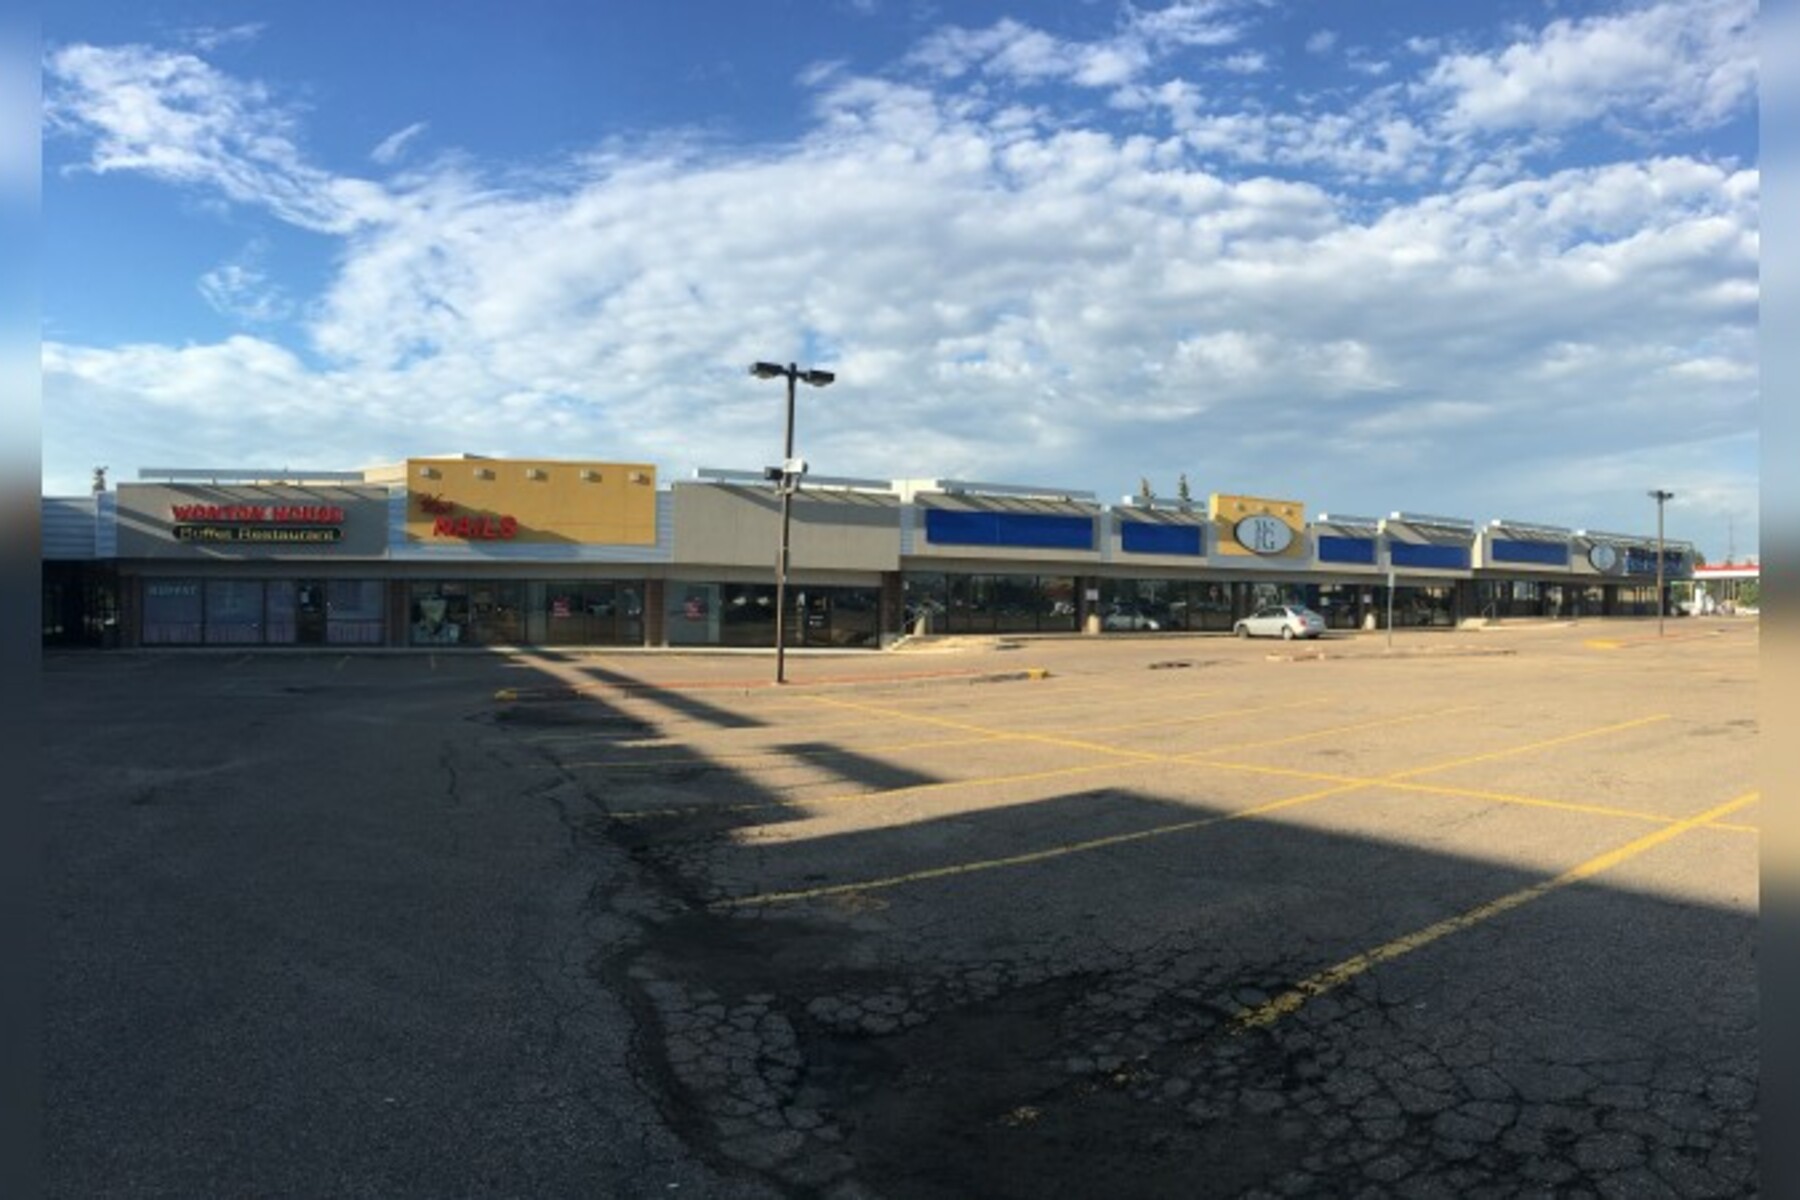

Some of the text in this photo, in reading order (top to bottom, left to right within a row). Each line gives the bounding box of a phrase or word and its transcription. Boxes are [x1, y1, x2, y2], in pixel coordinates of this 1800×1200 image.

[272, 505, 343, 524] HOUSE
[238, 528, 334, 541] Restaurant
[433, 514, 518, 540] NAILS
